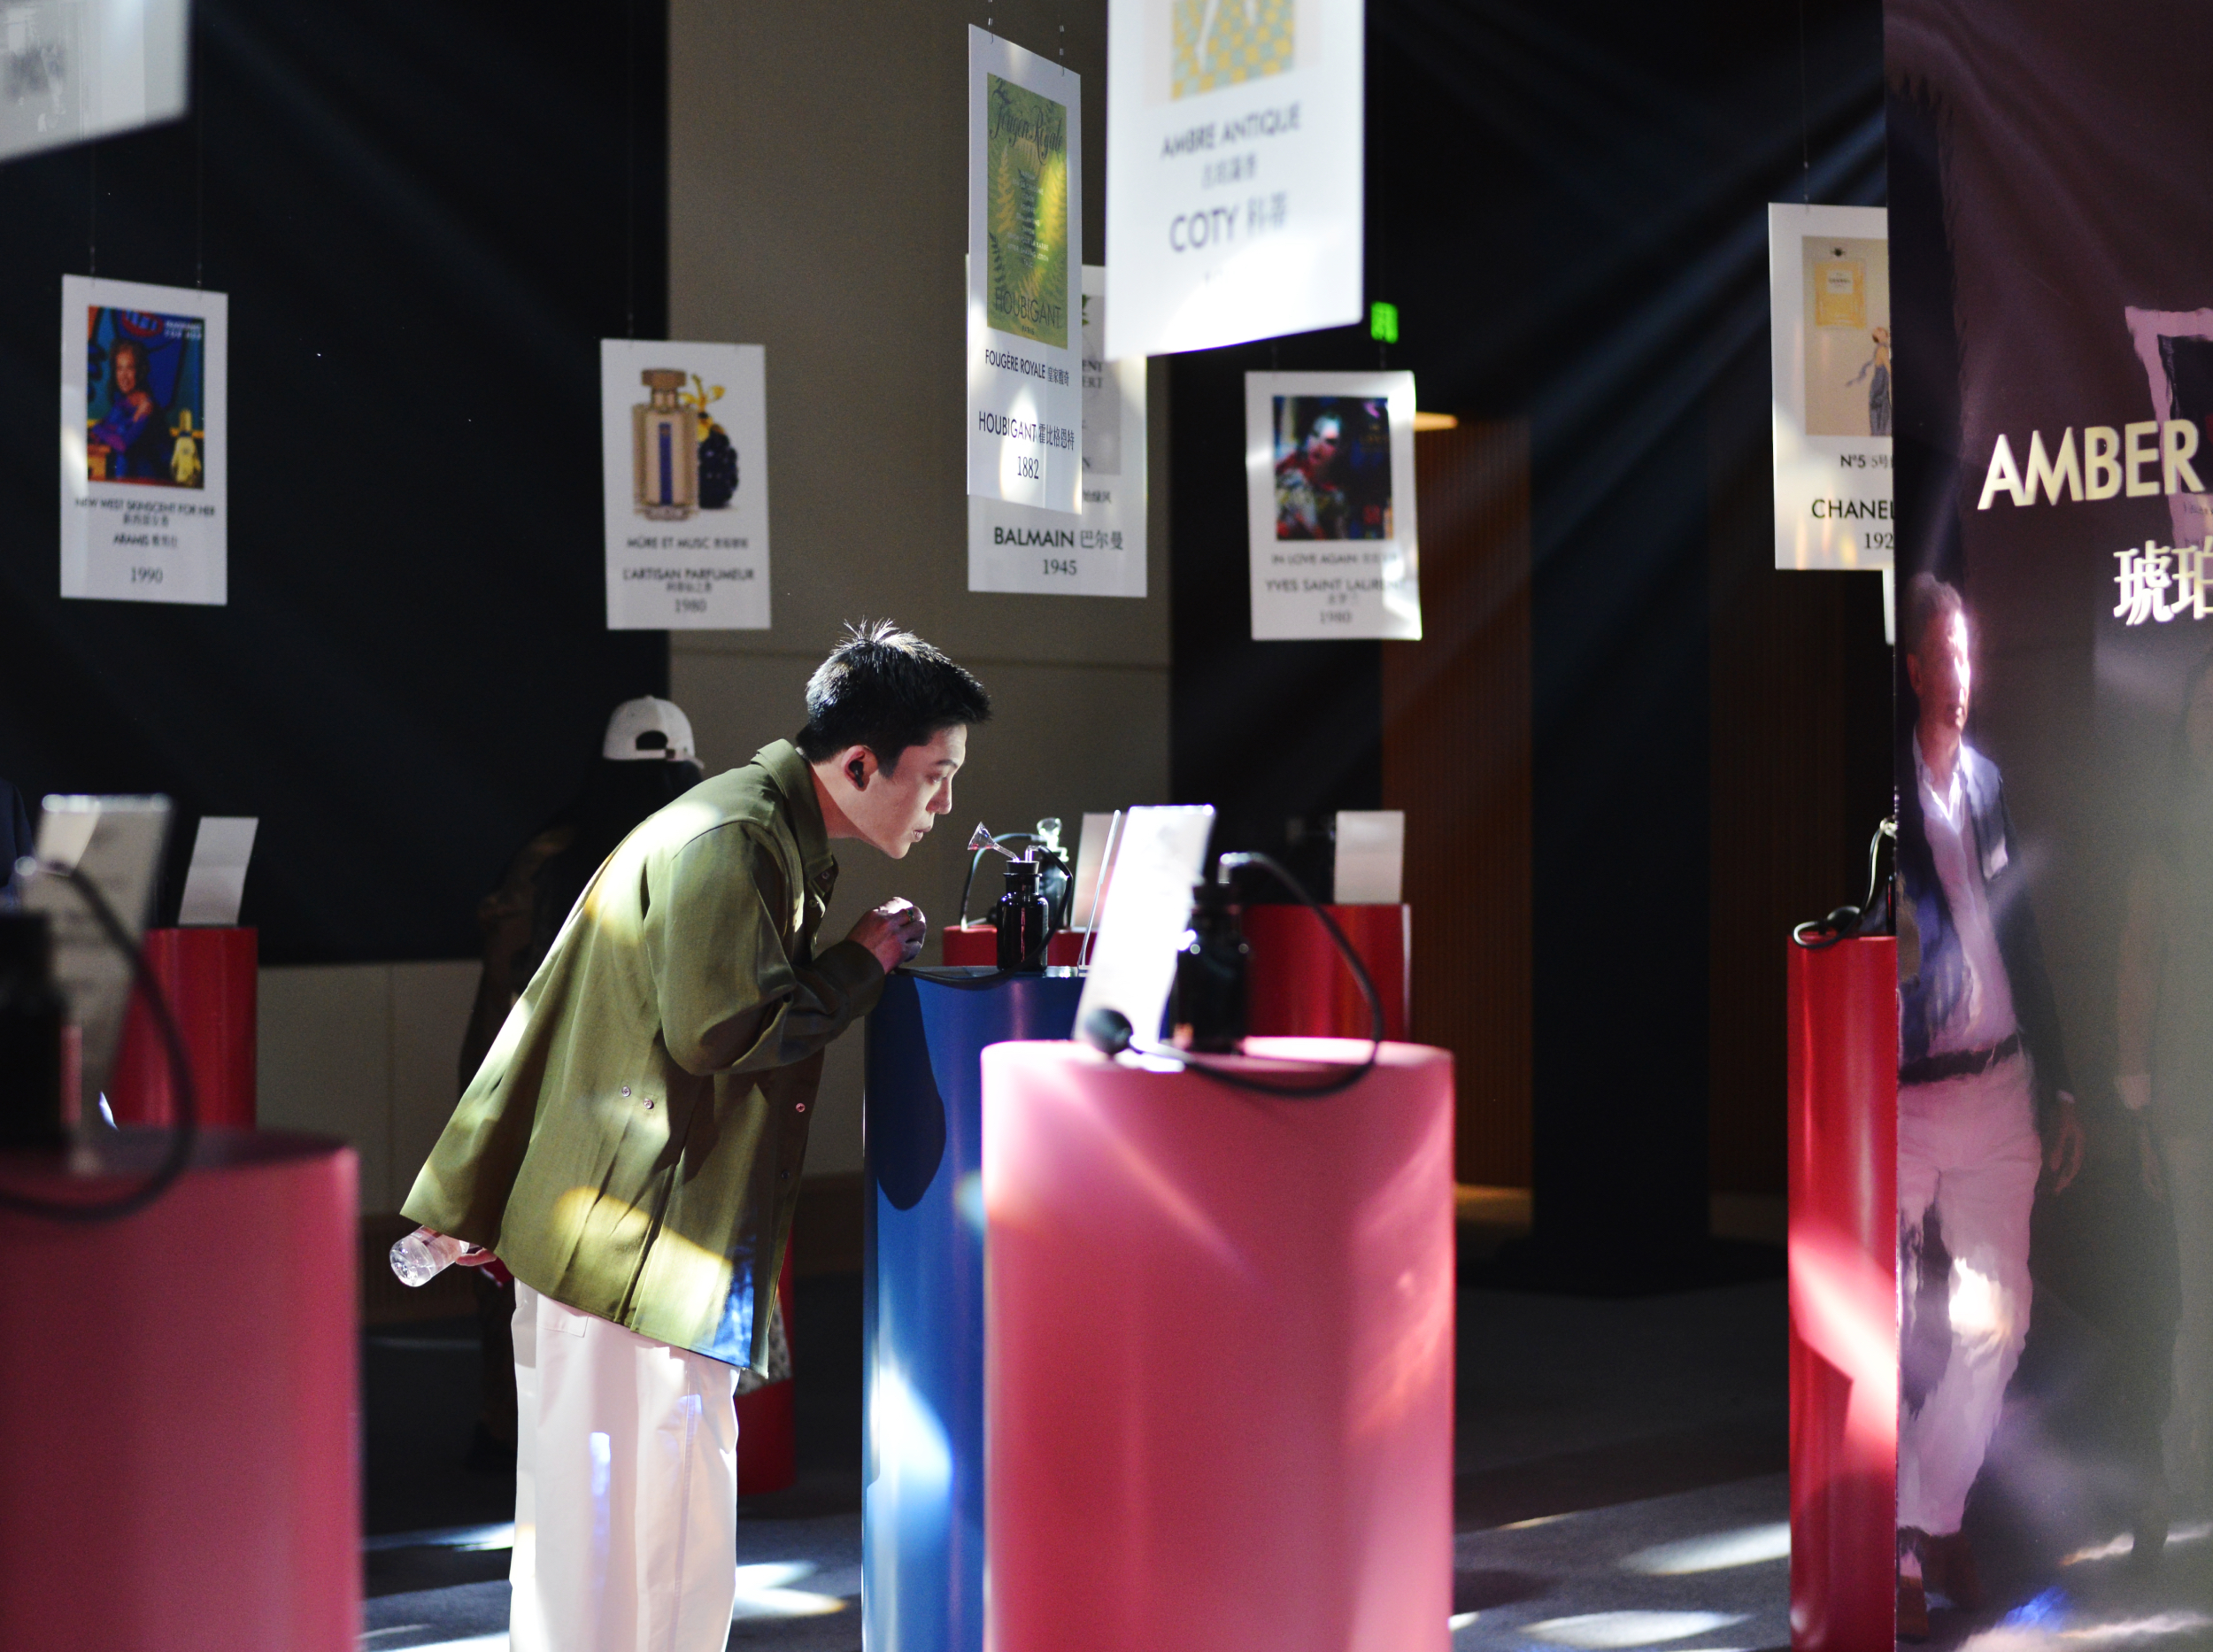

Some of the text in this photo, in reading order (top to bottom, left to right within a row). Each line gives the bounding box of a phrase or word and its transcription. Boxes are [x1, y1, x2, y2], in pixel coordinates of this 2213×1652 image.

[1160, 101, 1302, 159] AMBRE ANTIQUE
[1169, 204, 1239, 253] COTY
[995, 285, 1061, 329] HOUBIGANT
[1022, 325, 1035, 336] PARIS
[985, 349, 1019, 373] FOUGÈRE
[1020, 359, 1045, 380] ROYALE
[978, 411, 1075, 451] HOUBIGANT 霍比格恩特
[1017, 455, 1039, 480] 1882
[1977, 418, 2206, 511] AMBER
[994, 527, 1123, 551] BALMAIN 巴尔曼
[1865, 532, 1894, 549] 192
[131, 567, 164, 583] 1990
[1043, 558, 1078, 575] 1945
[1266, 579, 1405, 591] YVES SAINT LAURE
[2113, 536, 2213, 626] 琥珀
